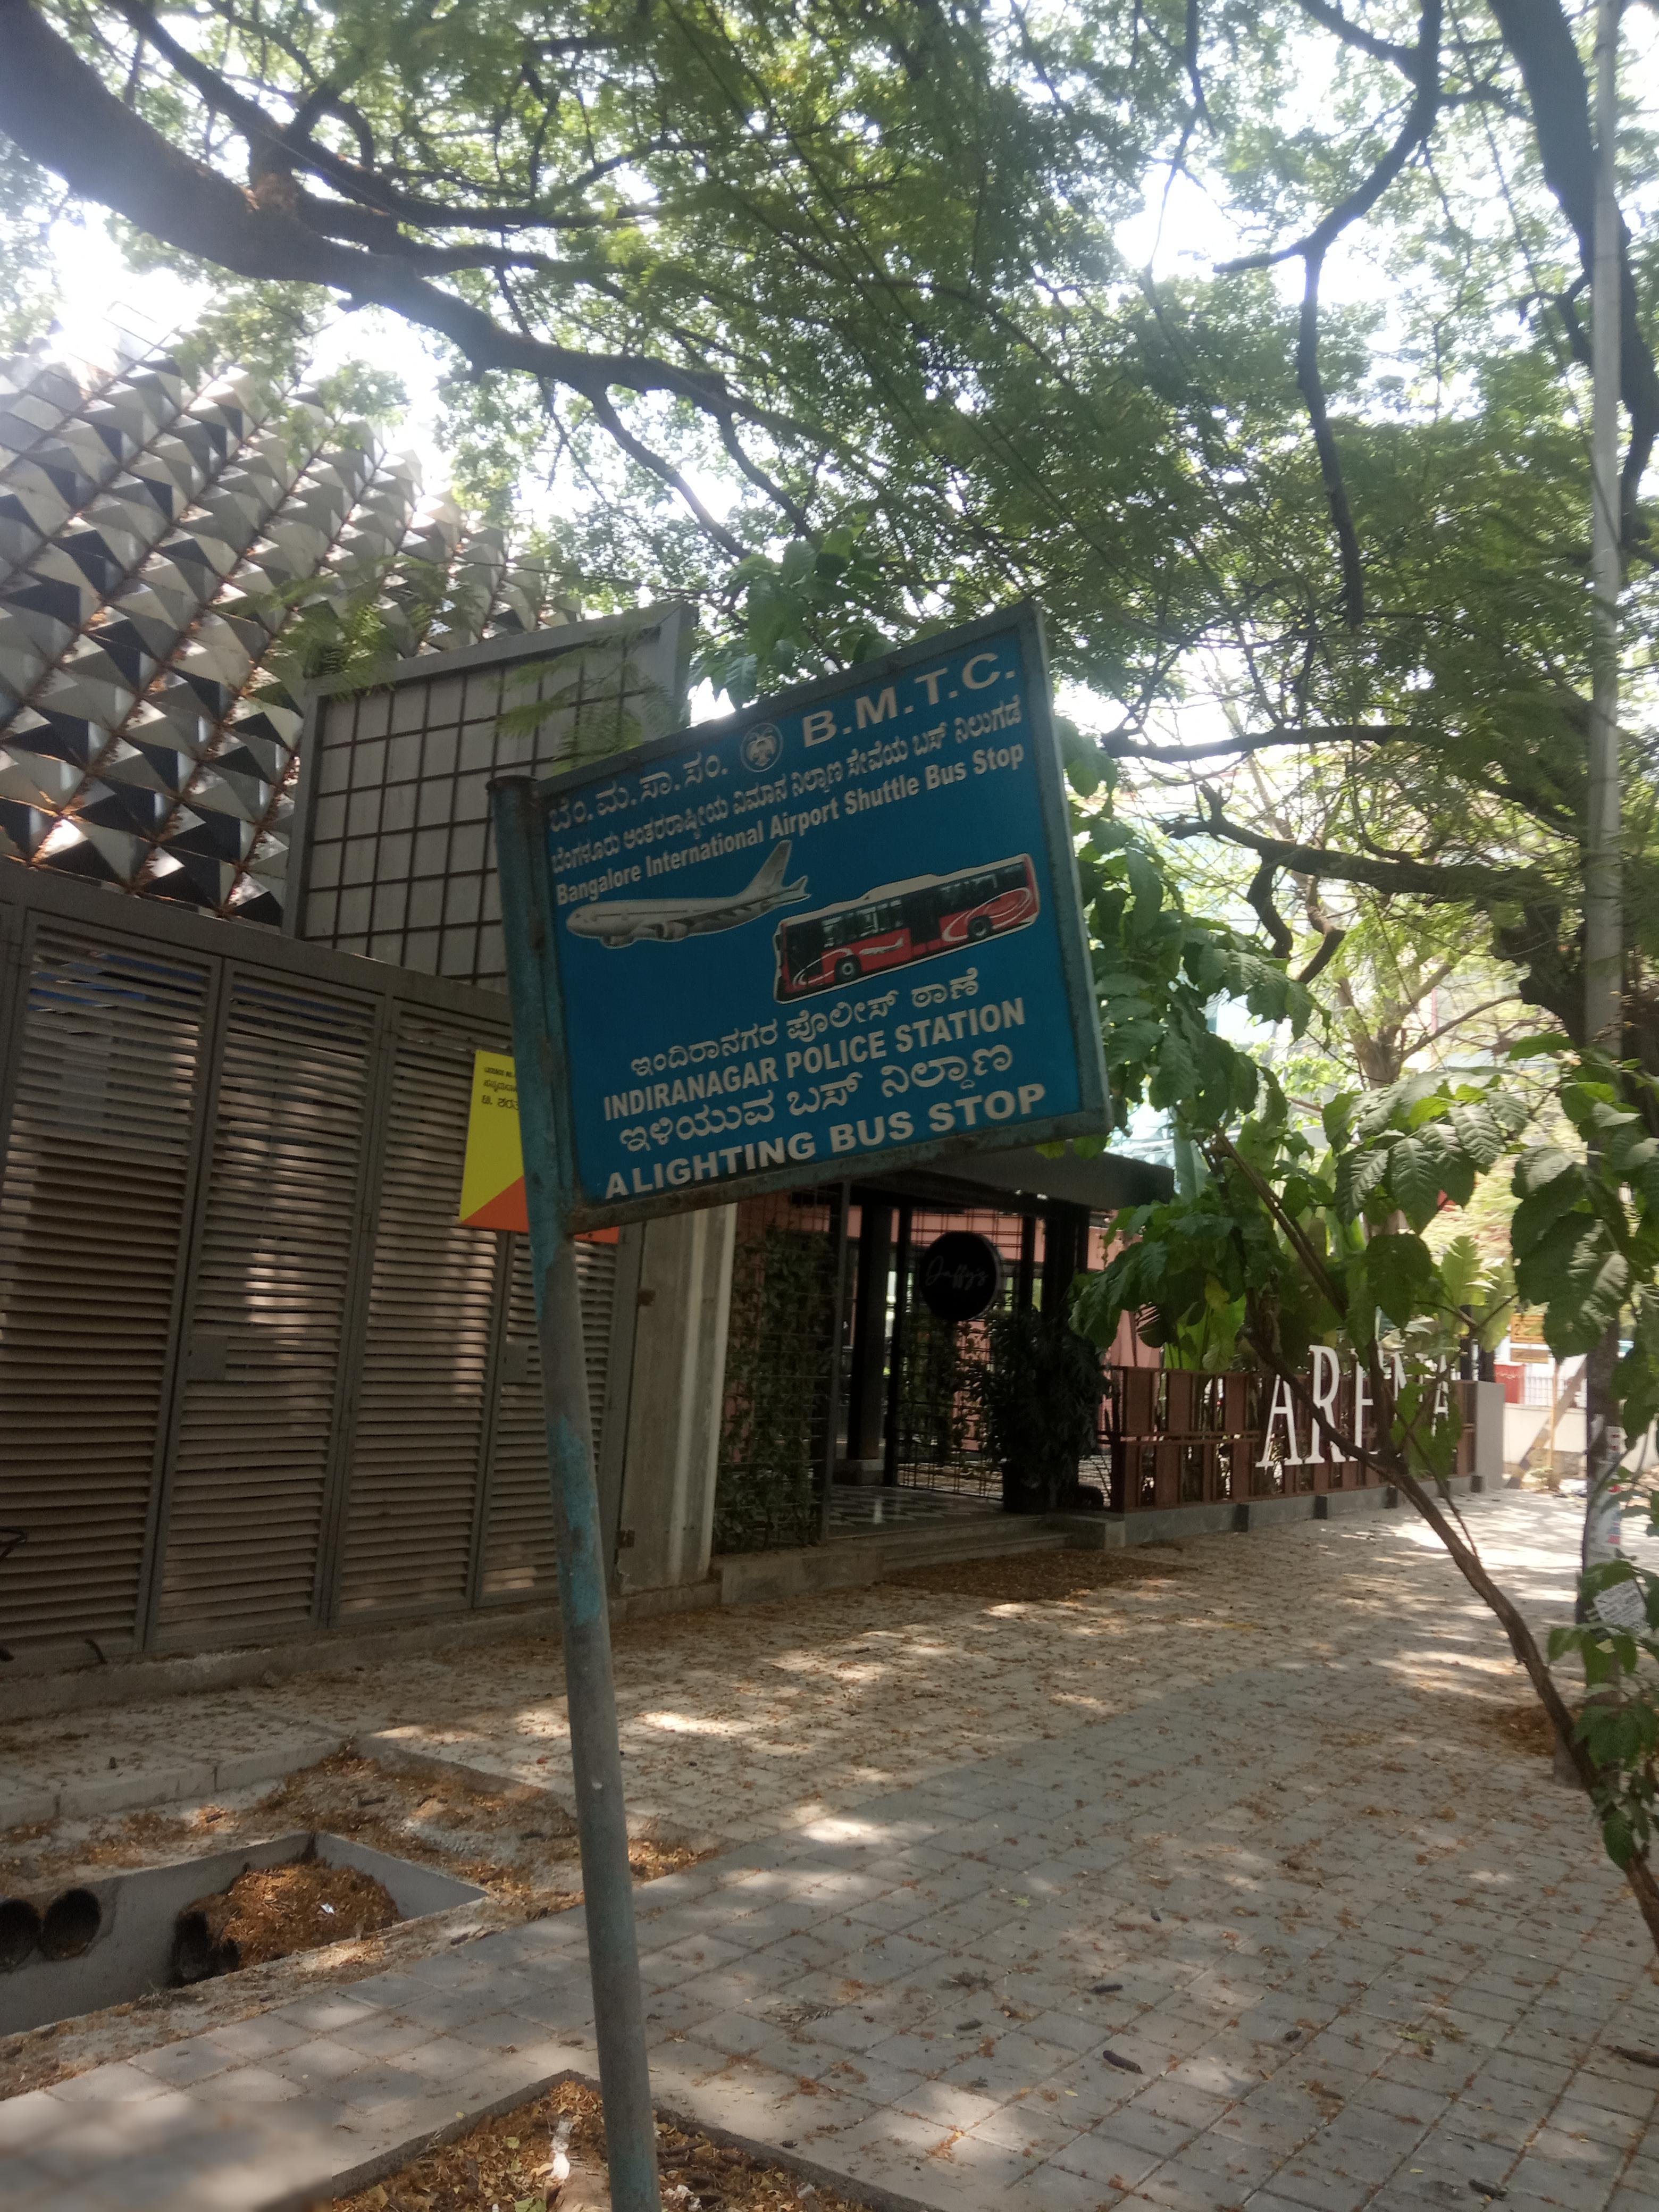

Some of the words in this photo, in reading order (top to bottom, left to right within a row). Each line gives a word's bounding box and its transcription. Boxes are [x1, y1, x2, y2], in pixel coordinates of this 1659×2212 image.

[802, 653, 1015, 747] B.M.T.C.
[733, 774, 788, 815] ವಿಮಾನ
[791, 760, 844, 797] ನಿಲ್ದಾಣ
[913, 722, 948, 756] ಬಸ್
[556, 865, 641, 905] Bangalore
[646, 819, 764, 877] International
[769, 798, 840, 840] Airport
[844, 774, 919, 815] Shuttle
[925, 761, 967, 790] Bus
[973, 743, 1025, 775] Stop
[604, 1057, 779, 1121] INDIRANAGAR
[785, 1030, 887, 1078] POLICE
[895, 998, 1025, 1053] STATION
[631, 1019, 778, 1076] ಇಂದಿರಾನಗರ
[911, 967, 979, 1007] ಠಾಣೆ
[605, 1131, 816, 1199] ALIGHTING
[829, 1111, 915, 1153] BUS
[928, 1083, 1046, 1132] STOP
[619, 1090, 775, 1151] ಇಳಿಯುವ
[786, 1071, 863, 1116] ಬಸ್
[880, 1044, 1013, 1098] ನಿಲ್ದಾಣ
